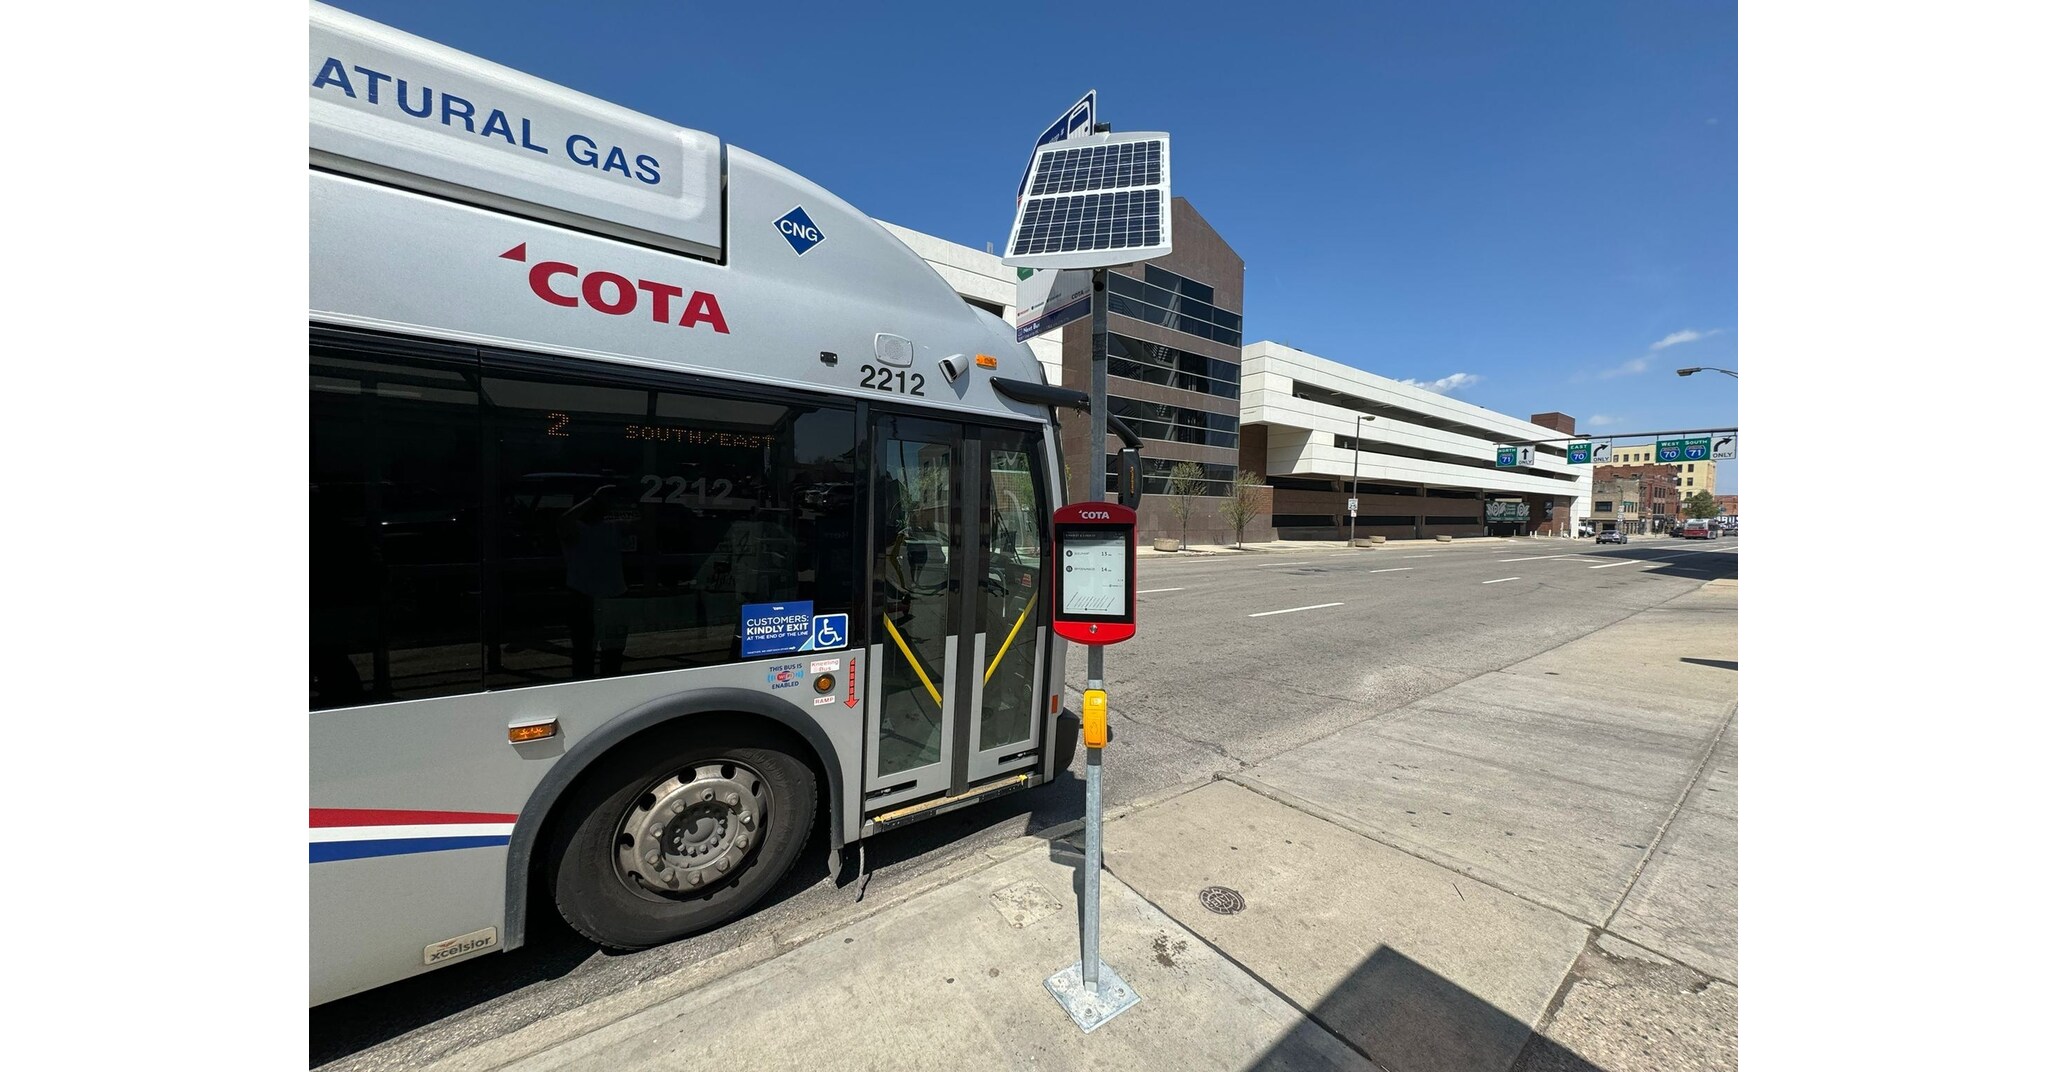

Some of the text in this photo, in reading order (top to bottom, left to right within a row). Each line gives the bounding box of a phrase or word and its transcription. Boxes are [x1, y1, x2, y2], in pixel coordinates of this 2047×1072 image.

[313, 56, 662, 185] ATURAL GAS
[779, 218, 819, 243] CNG
[528, 260, 730, 335] COTA
[860, 364, 925, 396] 2212
[547, 412, 776, 449] 2 SOUTH/EAST
[1663, 449, 1701, 458] 70 71
[639, 474, 734, 505] 2212
[1081, 511, 1110, 520] COTA
[746, 615, 810, 627] CUSTOMERS:
[746, 622, 809, 636] KINDLY EXIT
[772, 681, 800, 689] ENABLED
[815, 696, 834, 704] RAMP
[430, 937, 491, 961] xcelsior
